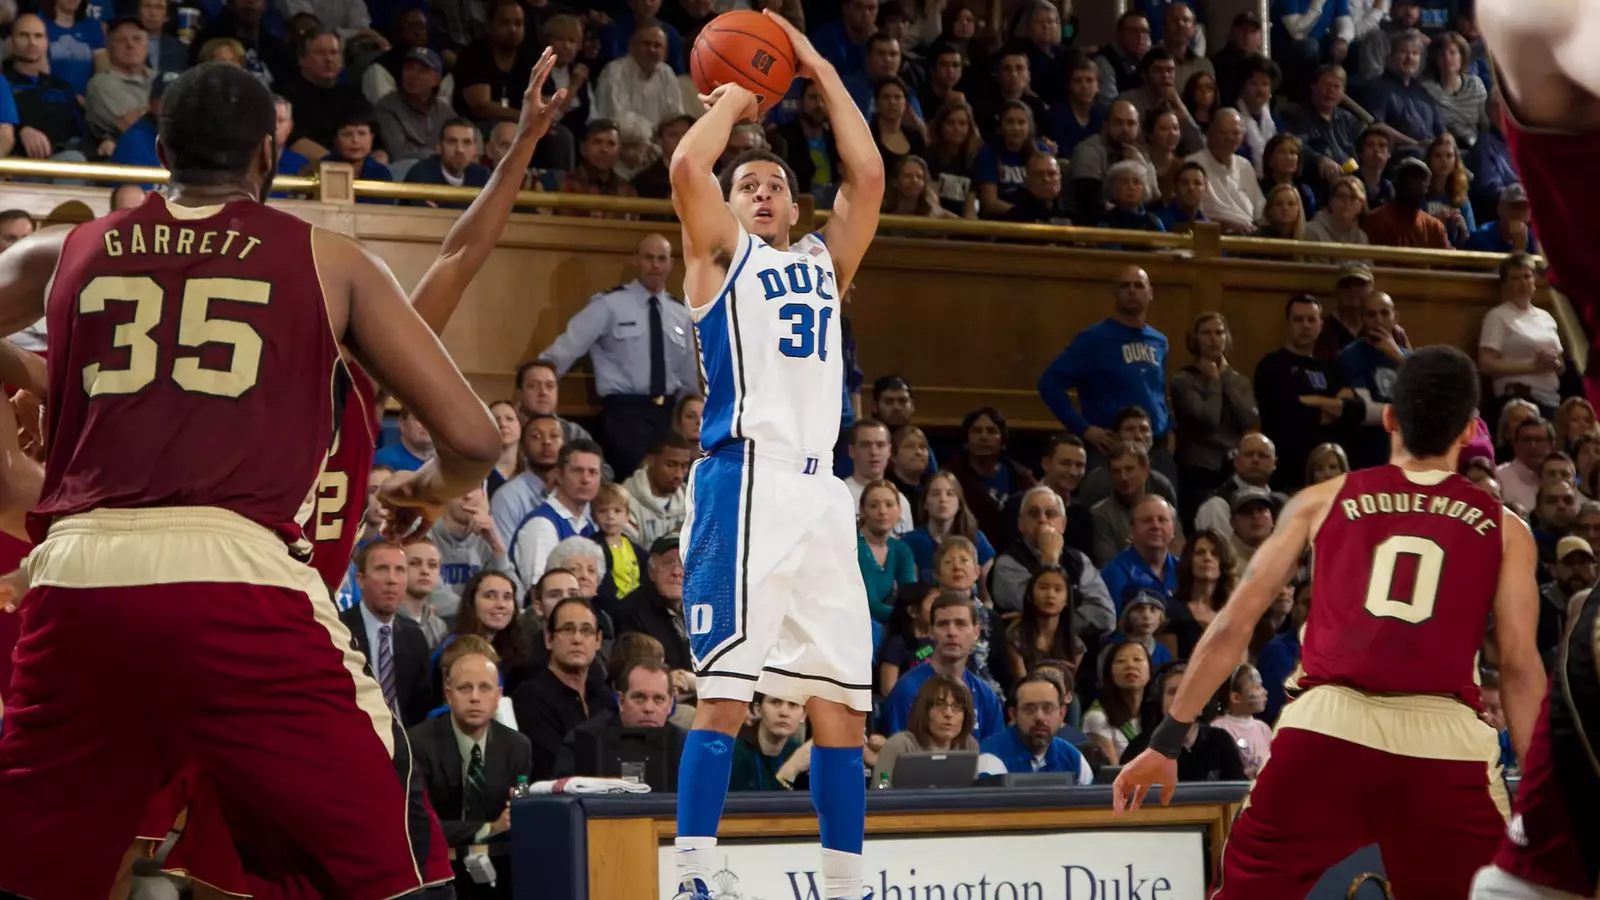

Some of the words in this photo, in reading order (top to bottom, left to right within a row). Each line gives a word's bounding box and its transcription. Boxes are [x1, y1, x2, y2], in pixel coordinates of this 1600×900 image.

[104, 223, 262, 260] GARRETT
[79, 276, 270, 398] 35
[1122, 342, 1160, 367] DUKE
[1341, 492, 1497, 537] ROQUEMORE
[1362, 534, 1446, 624] 0
[690, 603, 714, 635] D
[1061, 863, 1172, 900] Duke
